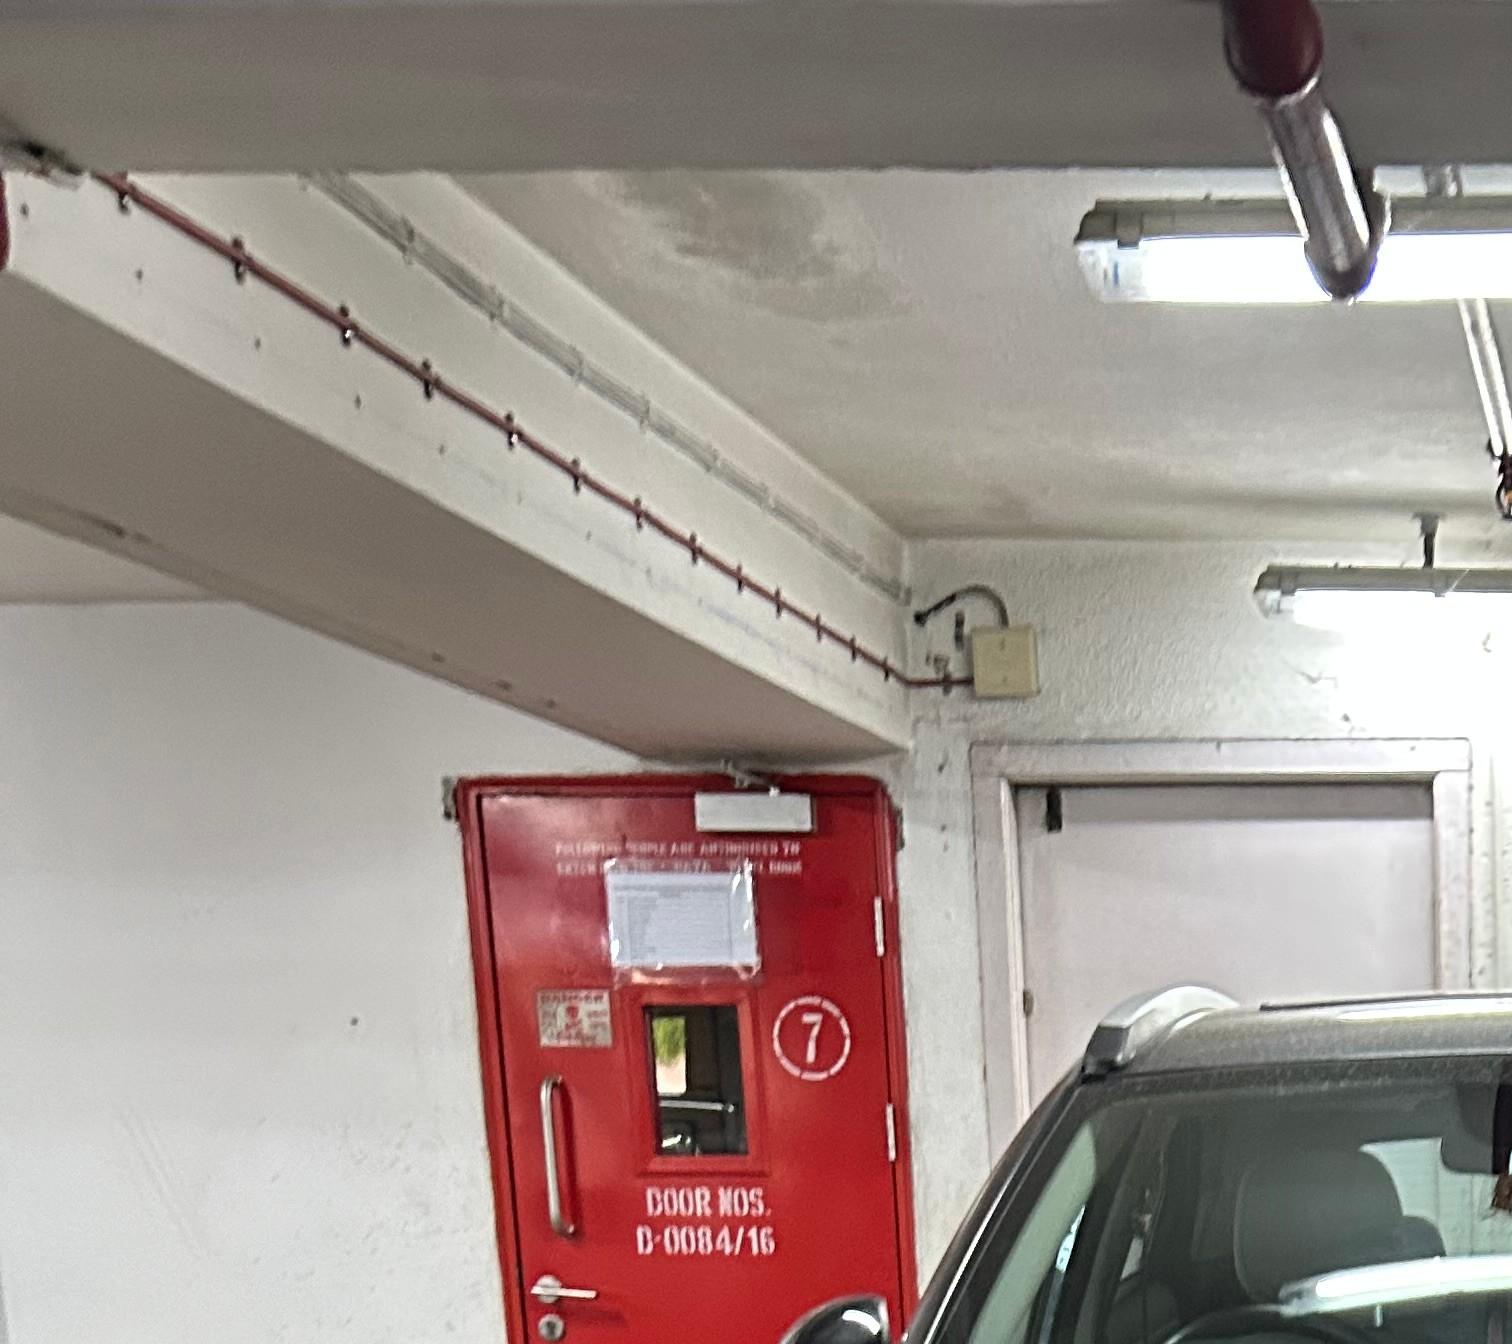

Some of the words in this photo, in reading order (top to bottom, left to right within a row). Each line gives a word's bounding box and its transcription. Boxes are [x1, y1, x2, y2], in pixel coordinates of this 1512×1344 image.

[802, 1012, 823, 1064] 7
[646, 1186, 712, 1216] DOOR
[718, 1186, 772, 1216] NOS.
